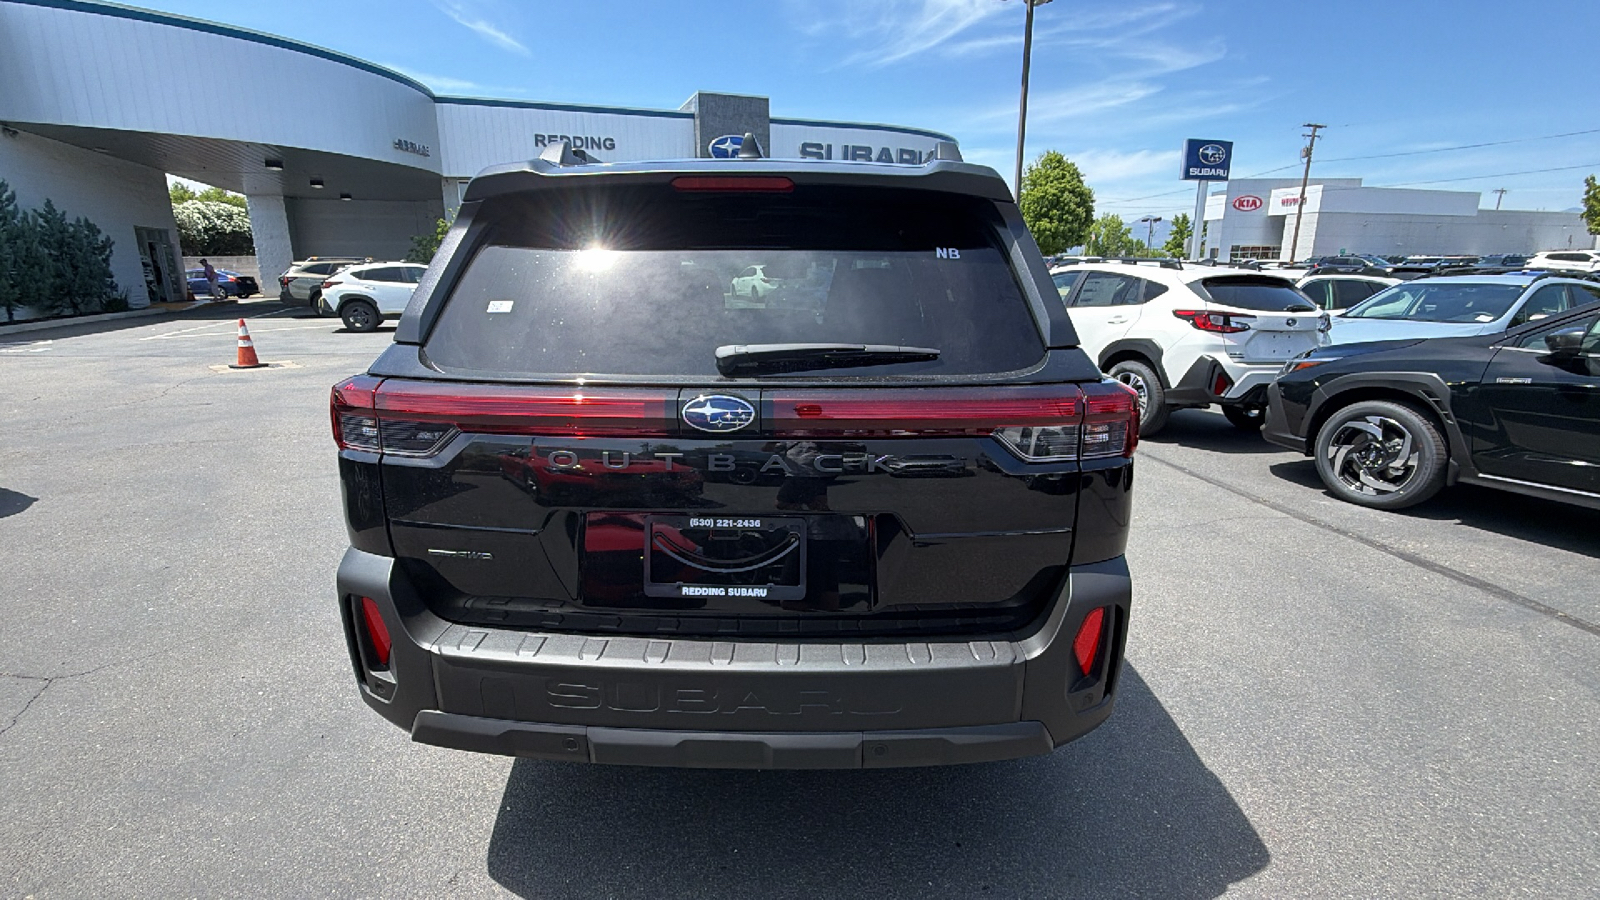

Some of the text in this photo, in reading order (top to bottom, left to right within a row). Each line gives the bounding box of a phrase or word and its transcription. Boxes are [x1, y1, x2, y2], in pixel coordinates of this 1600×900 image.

[534, 133, 616, 151] REDDING
[1189, 167, 1228, 177] SUBARU
[1238, 199, 1258, 208] KIA
[936, 246, 961, 259] NB
[547, 450, 896, 473] OUTBACK
[689, 518, 761, 527] (530) 221-2436
[682, 587, 768, 598] REDDING SUBARU
